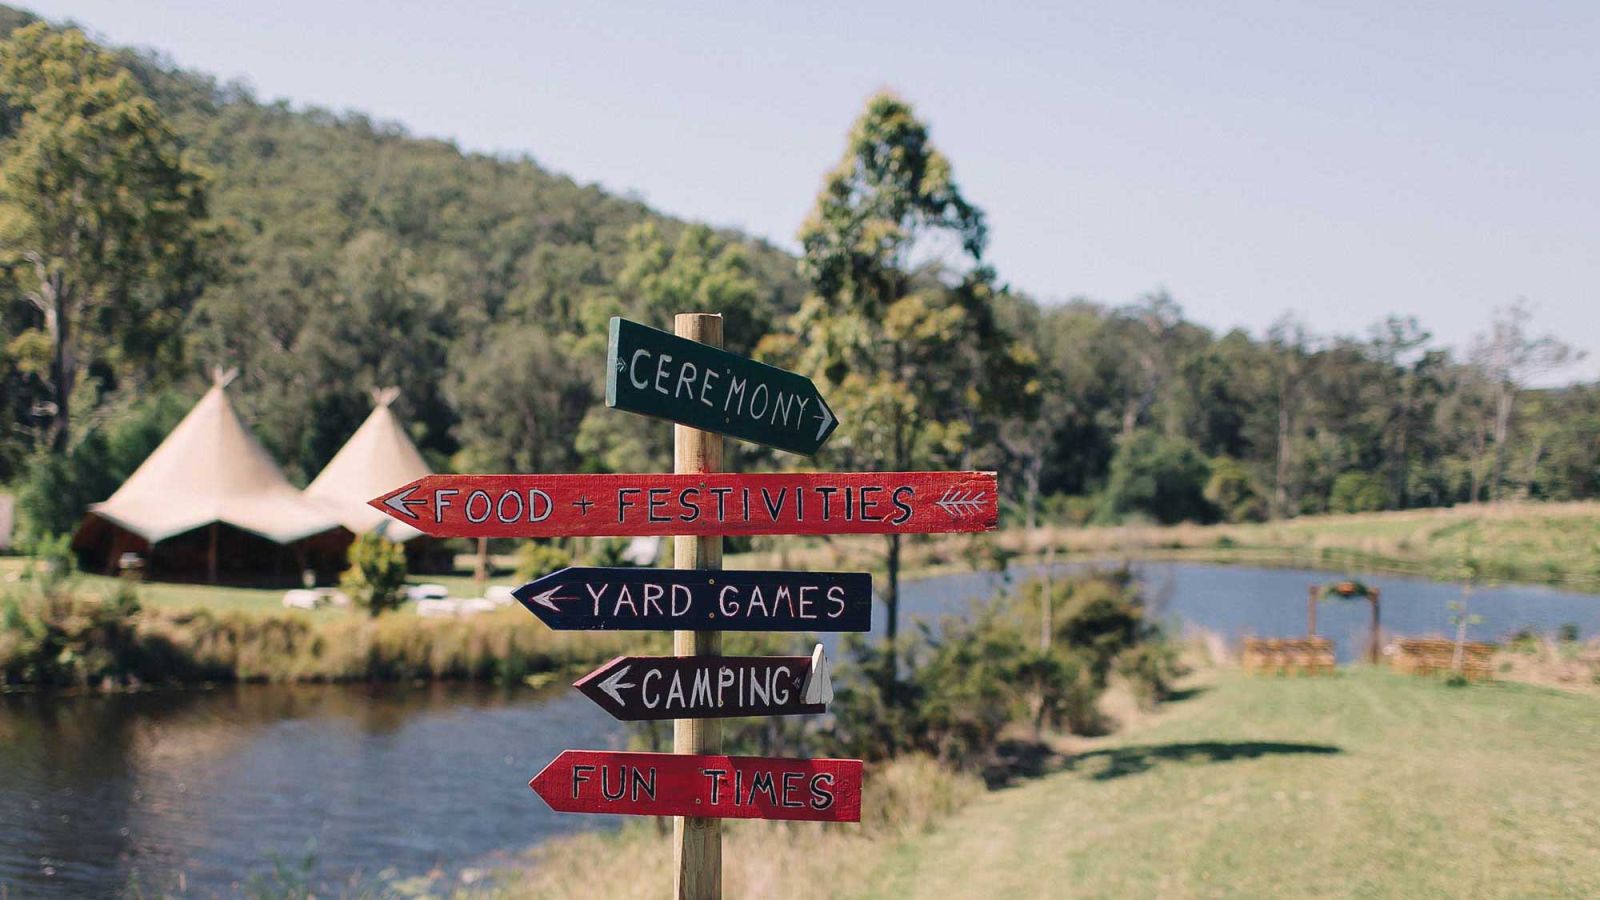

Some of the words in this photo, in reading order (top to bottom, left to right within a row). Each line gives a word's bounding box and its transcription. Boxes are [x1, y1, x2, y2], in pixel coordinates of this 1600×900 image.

[629, 349, 809, 430] CEREMONY
[433, 488, 553, 524] FOOD
[617, 486, 915, 525] FESTIVITIES
[585, 583, 692, 617] YARD
[719, 585, 846, 618] GAMES
[642, 665, 791, 709] CAMPING
[571, 765, 657, 801] FUN
[703, 769, 835, 811] TIMES
